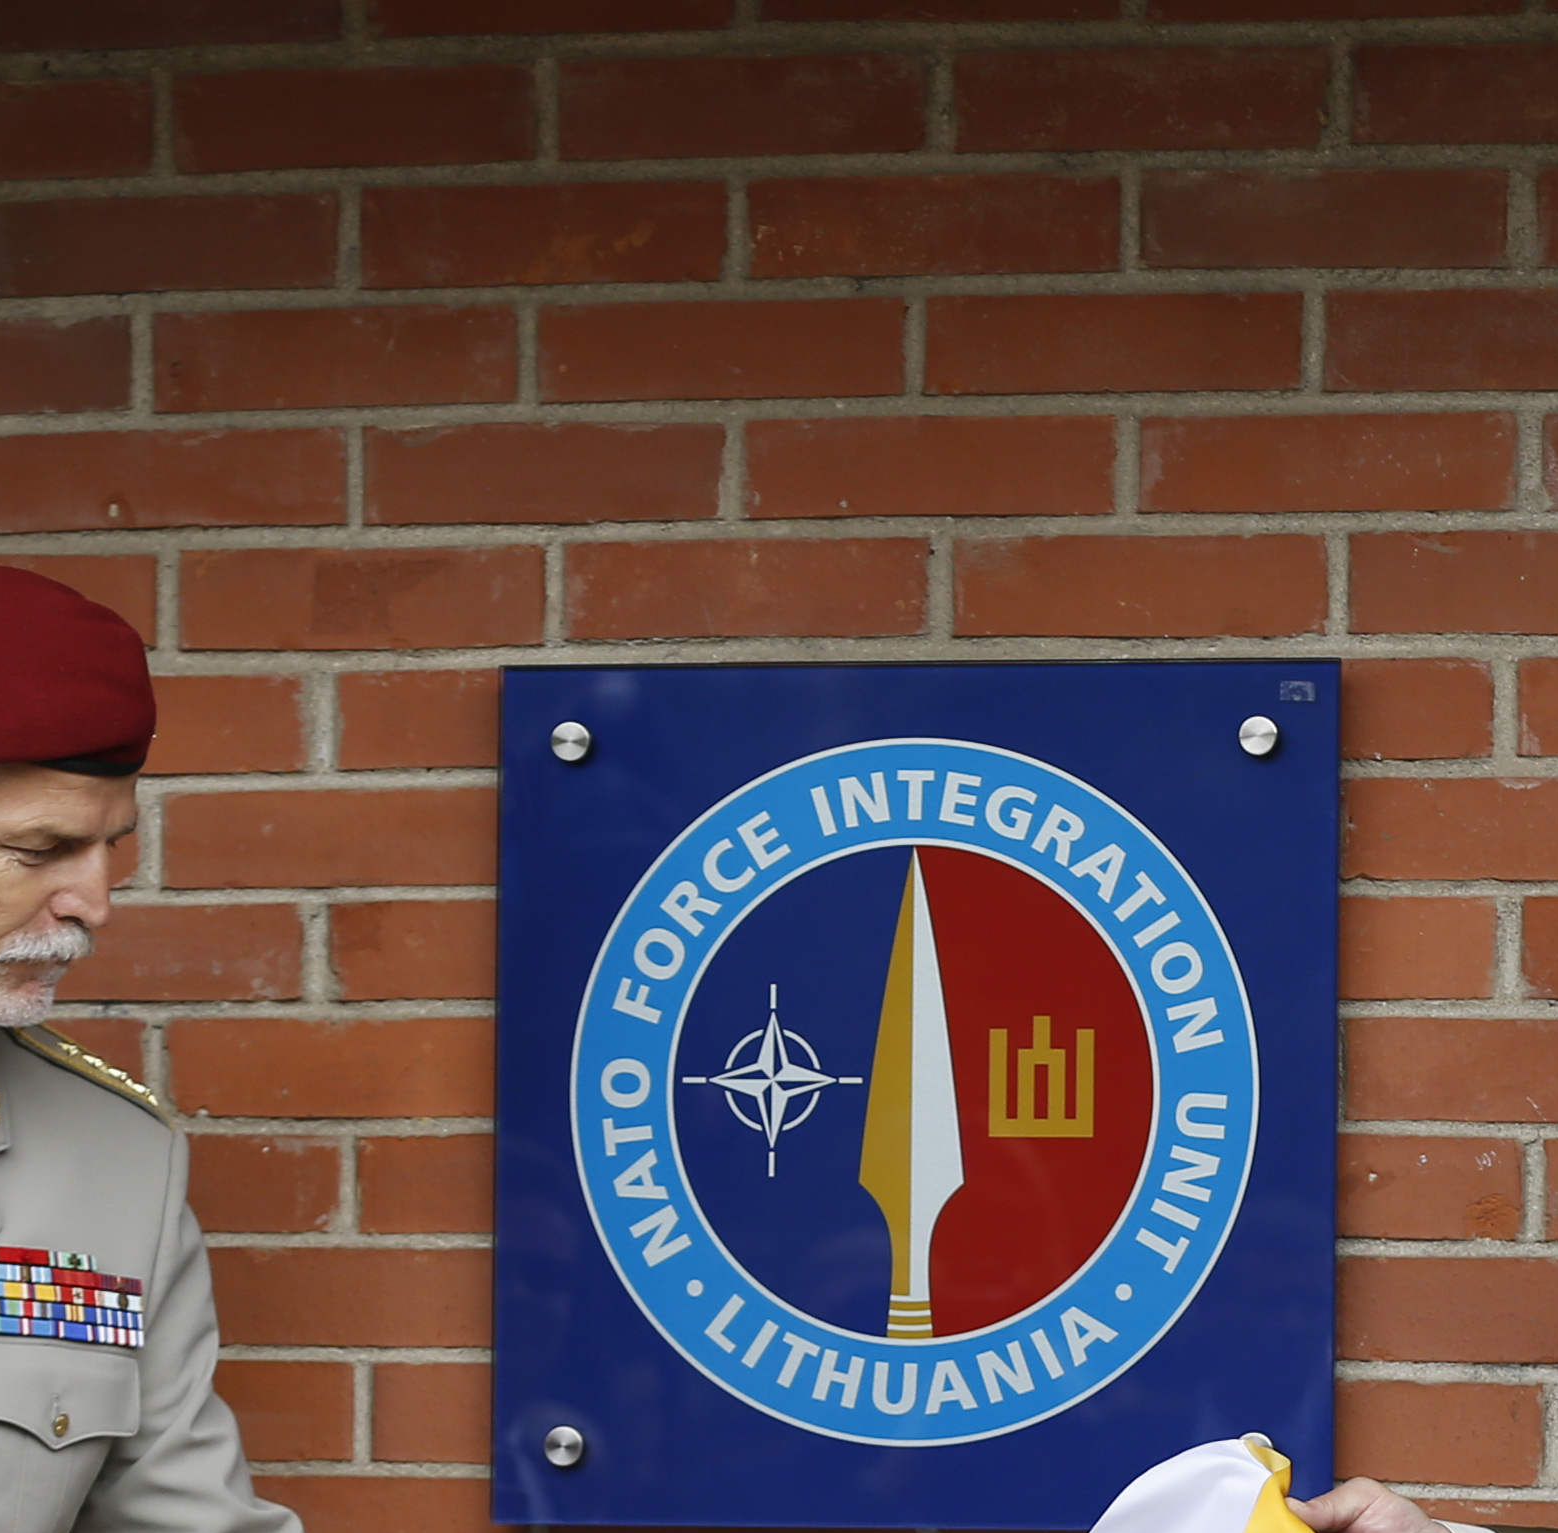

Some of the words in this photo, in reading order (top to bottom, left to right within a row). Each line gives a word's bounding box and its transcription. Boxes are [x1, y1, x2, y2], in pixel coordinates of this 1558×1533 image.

[612, 811, 792, 1025] FORCE
[810, 769, 1226, 1054] INTEGRATION
[600, 1057, 692, 1268] NATO
[1135, 1090, 1229, 1275] UNIT
[703, 1294, 1119, 1416] LITHUANIA
